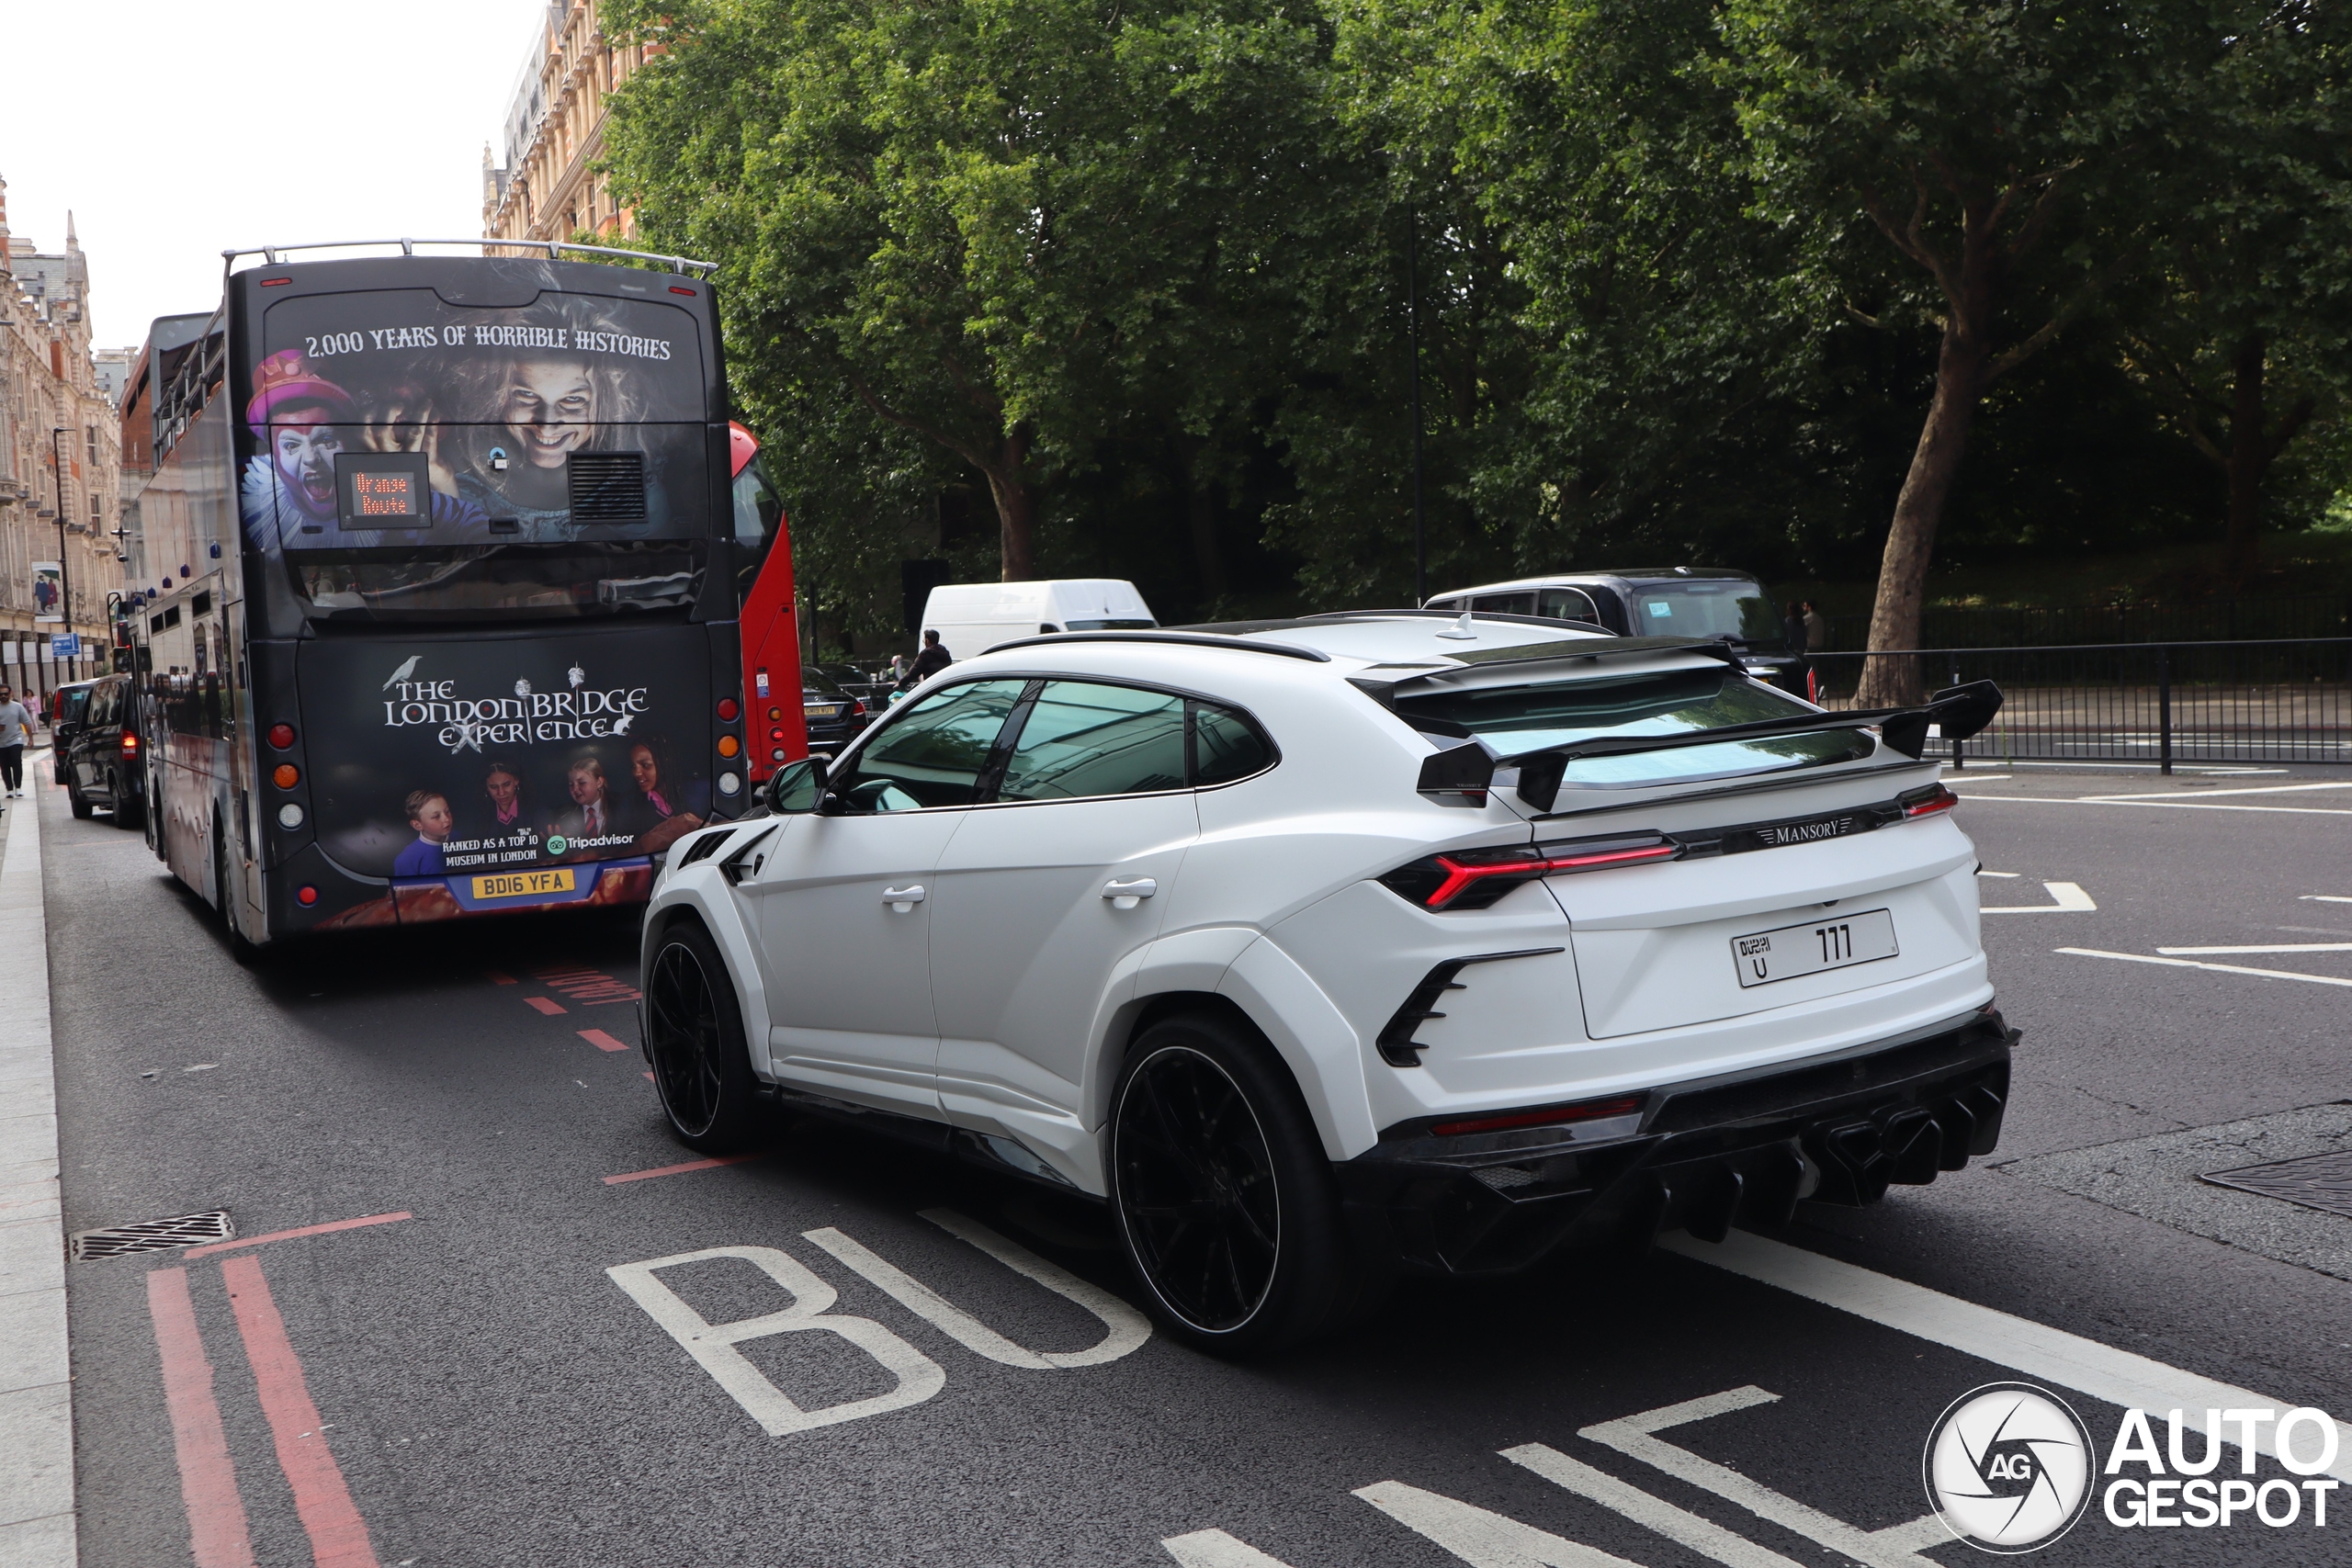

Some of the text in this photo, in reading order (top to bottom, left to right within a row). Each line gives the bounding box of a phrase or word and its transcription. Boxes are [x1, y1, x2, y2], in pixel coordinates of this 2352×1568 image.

[306, 325, 671, 360] 2,000 YEARS OF HORRIBLE HISTORIES
[362, 495, 407, 514] Route
[396, 680, 457, 702] THE
[383, 686, 650, 728] LONDON BRIDGE
[438, 717, 608, 754] EXPERIENCE
[442, 834, 538, 852] RANKED AS A TOP 10
[567, 833, 635, 850] Tripadvisor
[1776, 820, 1838, 844] MANSORY
[446, 850, 537, 867] MUSEUM IN LONDON
[483, 873, 564, 896] BD16 YFA
[1753, 957, 1768, 979] U
[605, 1207, 1154, 1437] BU
